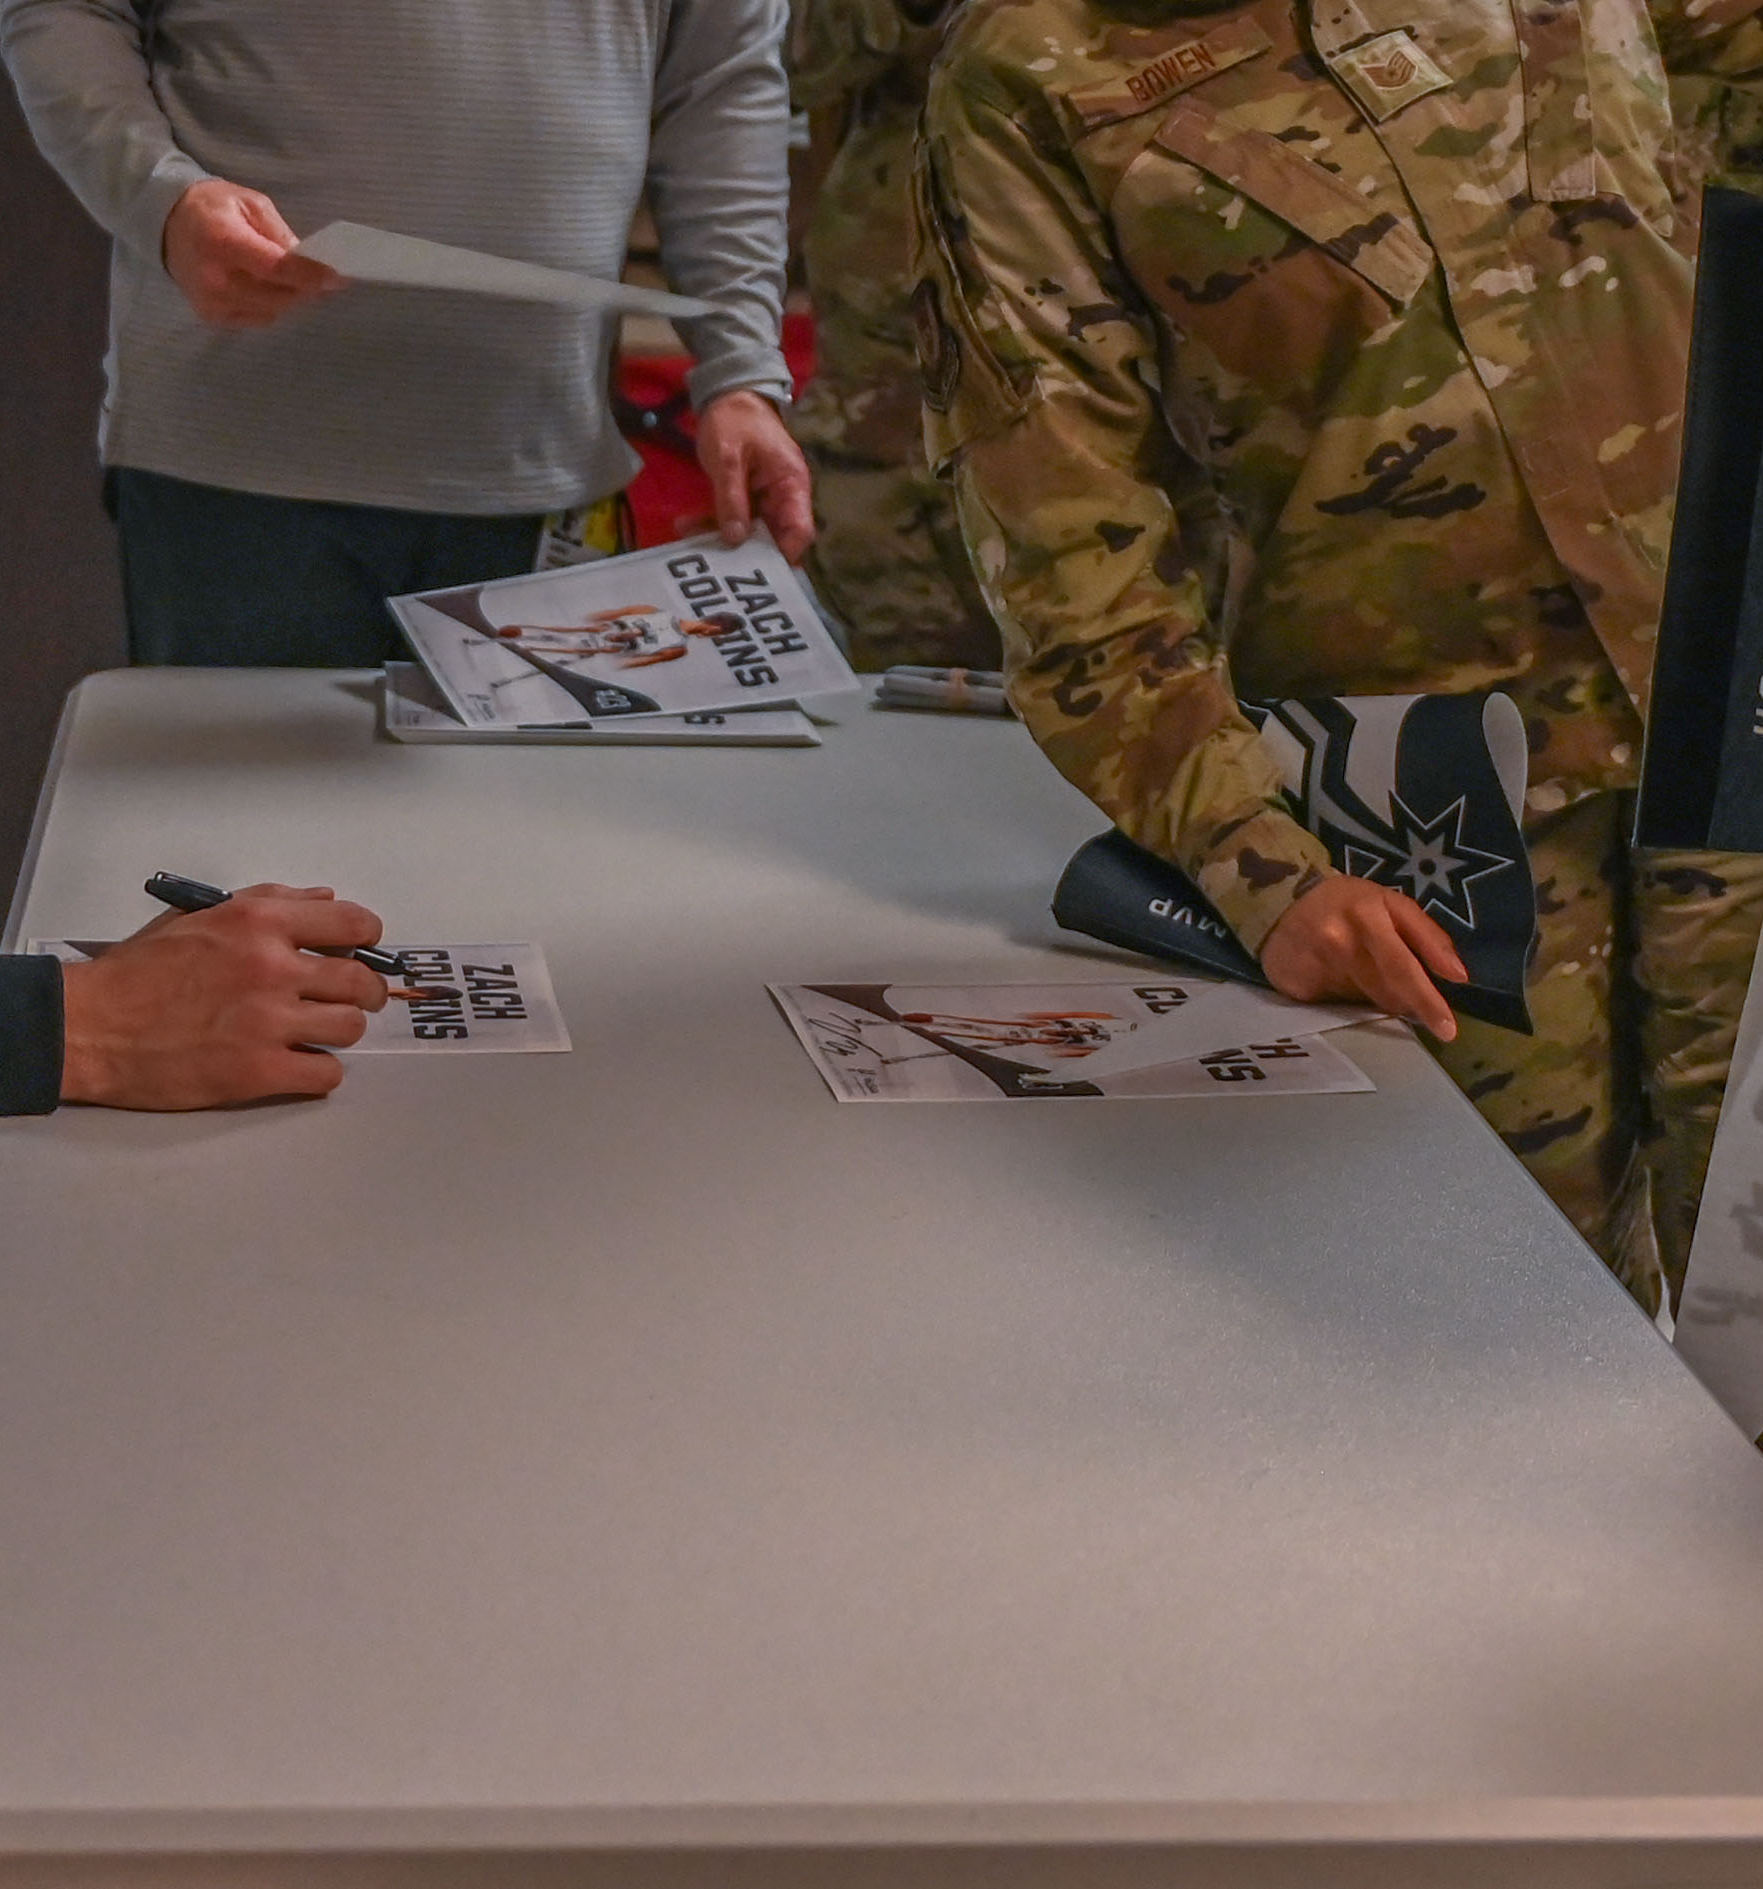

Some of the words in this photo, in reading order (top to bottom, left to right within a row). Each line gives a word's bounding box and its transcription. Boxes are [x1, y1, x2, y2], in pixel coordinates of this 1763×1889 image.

[1125, 43, 1217, 103] BOWEN
[668, 553, 781, 689] COLINS
[723, 568, 810, 657] ZACH
[397, 949, 469, 1040] COLINS
[461, 964, 528, 1020] ZACH
